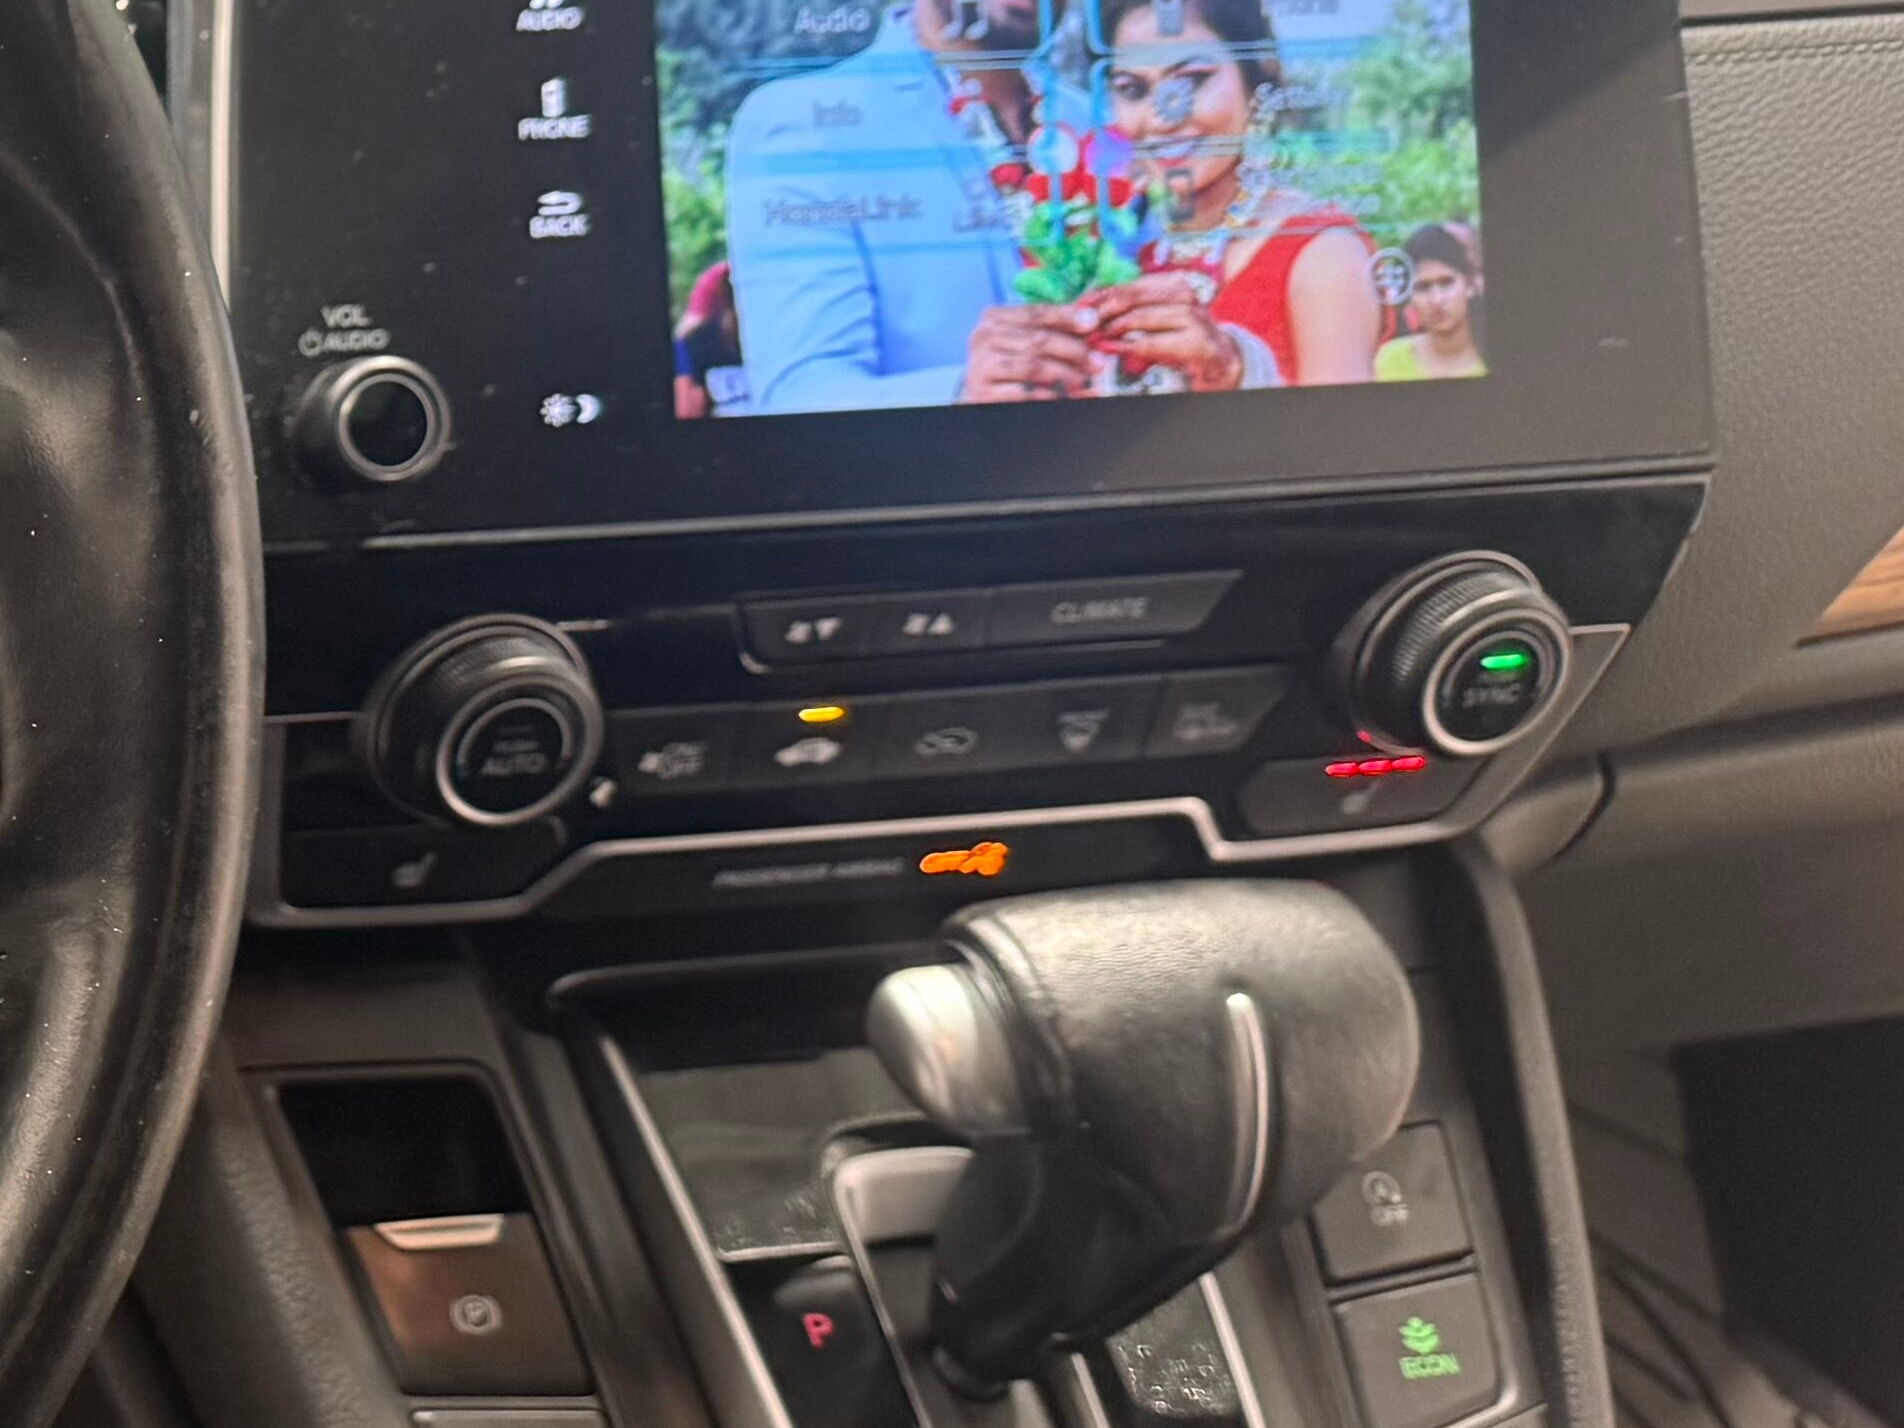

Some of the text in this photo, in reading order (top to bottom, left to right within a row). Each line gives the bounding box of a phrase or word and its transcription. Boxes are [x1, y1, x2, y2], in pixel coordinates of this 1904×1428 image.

[320, 303, 374, 329] VOL
[323, 327, 391, 352] AUDIO
[802, 1312, 835, 1349] P
